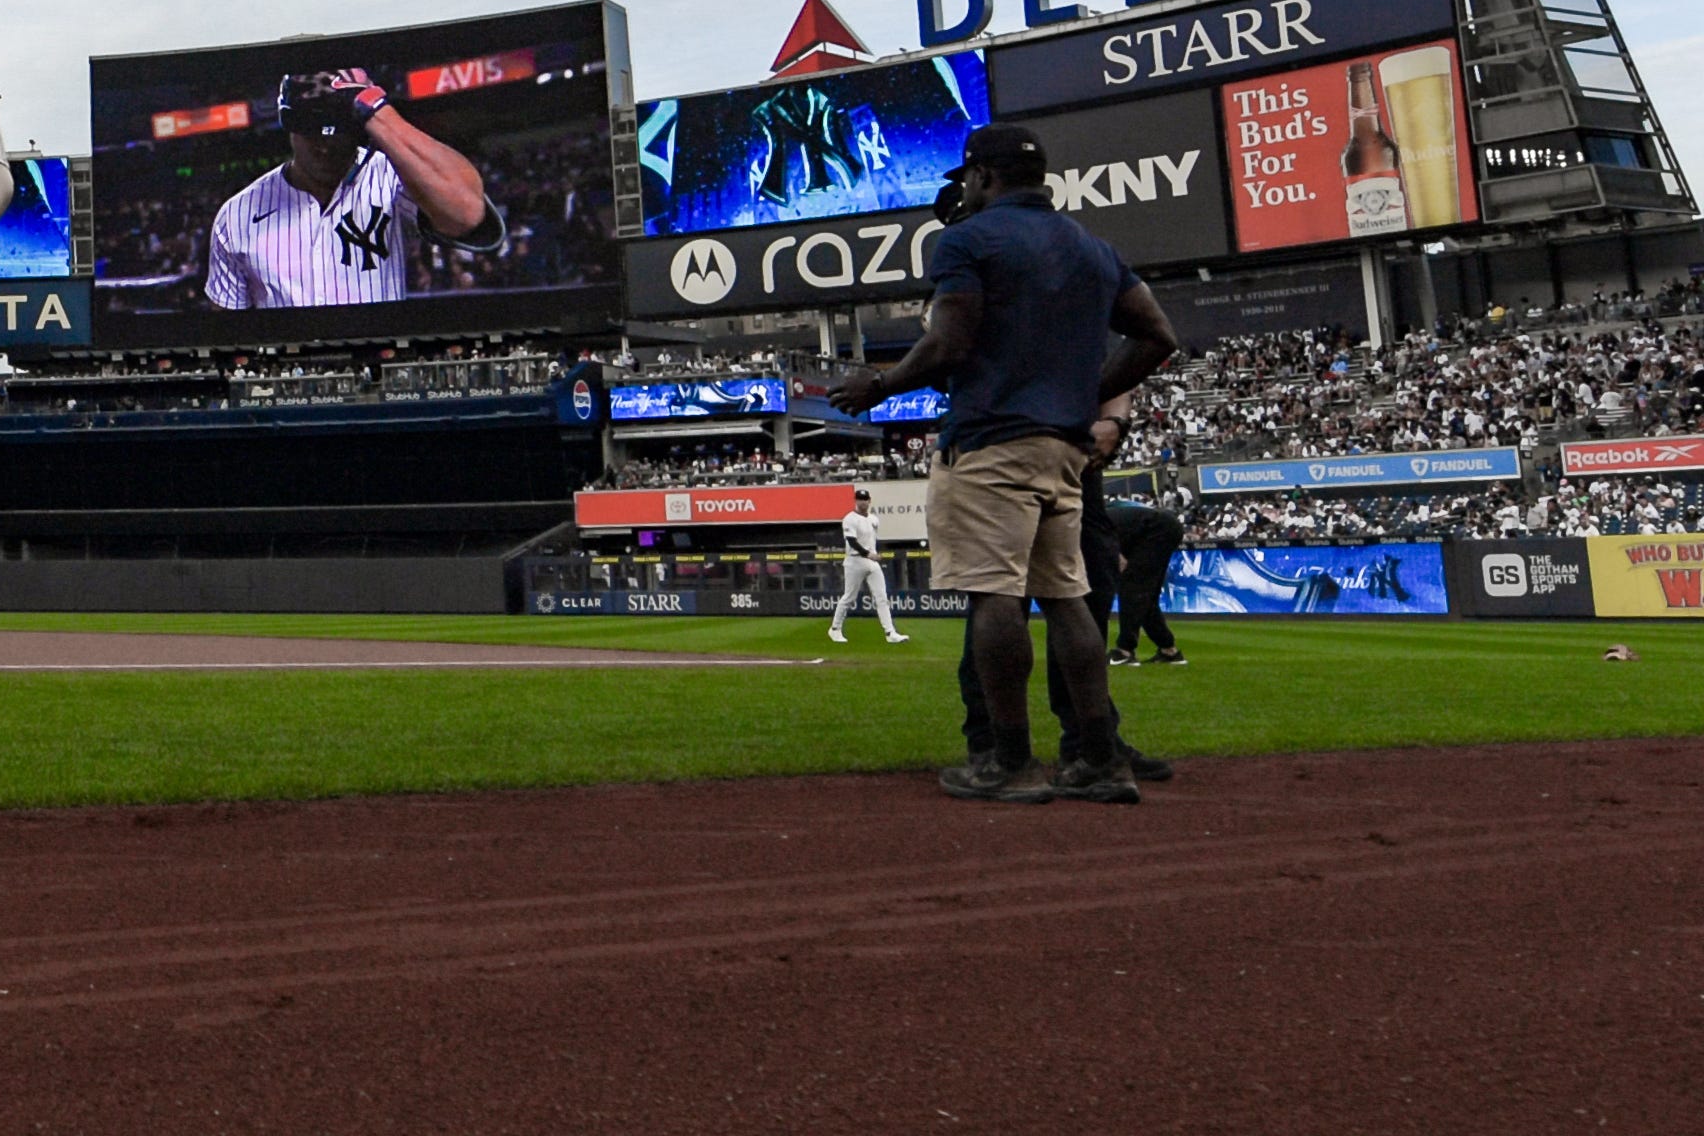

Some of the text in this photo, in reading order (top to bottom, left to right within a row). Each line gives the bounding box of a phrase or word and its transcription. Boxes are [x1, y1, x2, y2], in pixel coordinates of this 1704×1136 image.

[436, 58, 503, 94] AVIS
[1233, 83, 1309, 118] This
[1237, 110, 1328, 149] Bud's
[1241, 151, 1296, 179] For
[1044, 149, 1200, 211] DKNY
[1242, 179, 1317, 209] You.
[762, 220, 945, 293] razr
[1431, 459, 1492, 472] FANDUEL
[1566, 447, 1649, 468] Reebok
[1232, 470, 1284, 483] FANDUEL
[1328, 465, 1384, 478] FANDUEL
[695, 499, 755, 513] TOYOTA
[870, 505, 894, 515] ANK
[897, 505, 912, 514] OF
[1529, 555, 1551, 565] THE
[1625, 543, 1704, 564] WHO BU
[1489, 565, 1520, 586] GS
[1530, 564, 1579, 575] GOTHAM
[1531, 574, 1576, 585] SPORTS
[1532, 584, 1555, 594] APP
[562, 597, 602, 608] CLEAR
[628, 594, 683, 612] STARR
